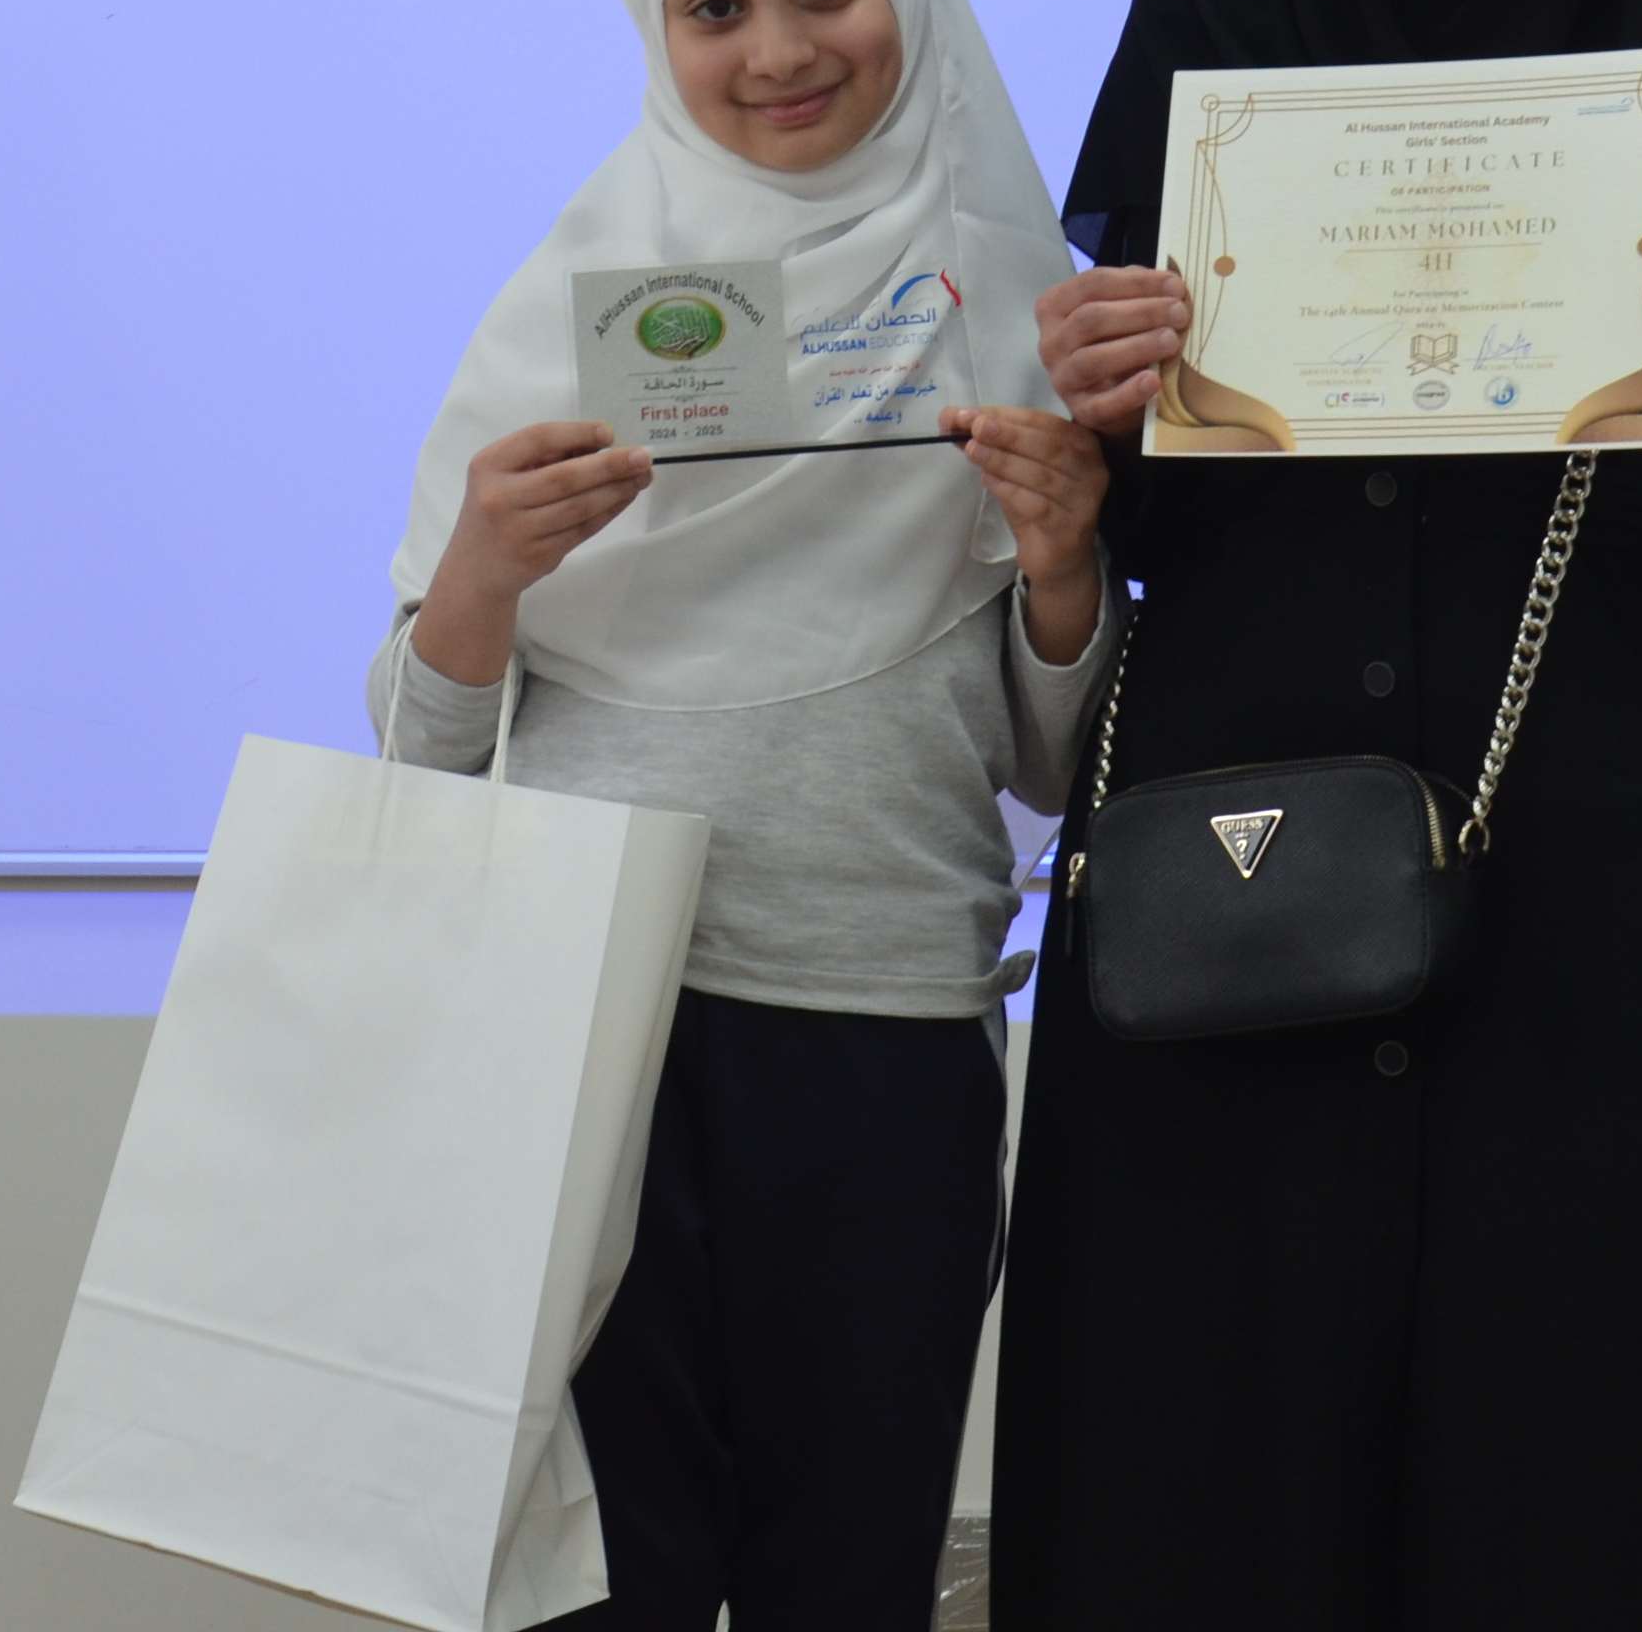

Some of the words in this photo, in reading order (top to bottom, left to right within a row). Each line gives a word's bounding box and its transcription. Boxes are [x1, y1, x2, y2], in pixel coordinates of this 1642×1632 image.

[1345, 123, 1359, 134] Al
[1361, 122, 1406, 133] Hussan
[1408, 115, 1491, 131] International
[1493, 114, 1550, 128] Academy
[1441, 135, 1488, 147] Section
[1333, 150, 1566, 178] CERTIFICATE
[1407, 184, 1491, 195] PARTICIPATION
[1320, 223, 1417, 243] MARIAM
[1428, 217, 1557, 240] MOHAMED
[594, 283, 647, 339] AlHussan
[646, 271, 724, 296] International
[725, 282, 766, 328] School
[1299, 306, 1317, 318] The
[1349, 304, 1390, 316] Annual
[800, 312, 862, 341] للتعليم
[865, 307, 937, 332] الحصان
[802, 339, 867, 355] ALHUSSAN
[689, 375, 725, 392] سورة
[640, 405, 678, 422] First
[683, 404, 730, 422] place
[649, 428, 678, 440] 2024
[695, 424, 725, 437] 2025
[1221, 818, 1265, 833] GUESS
